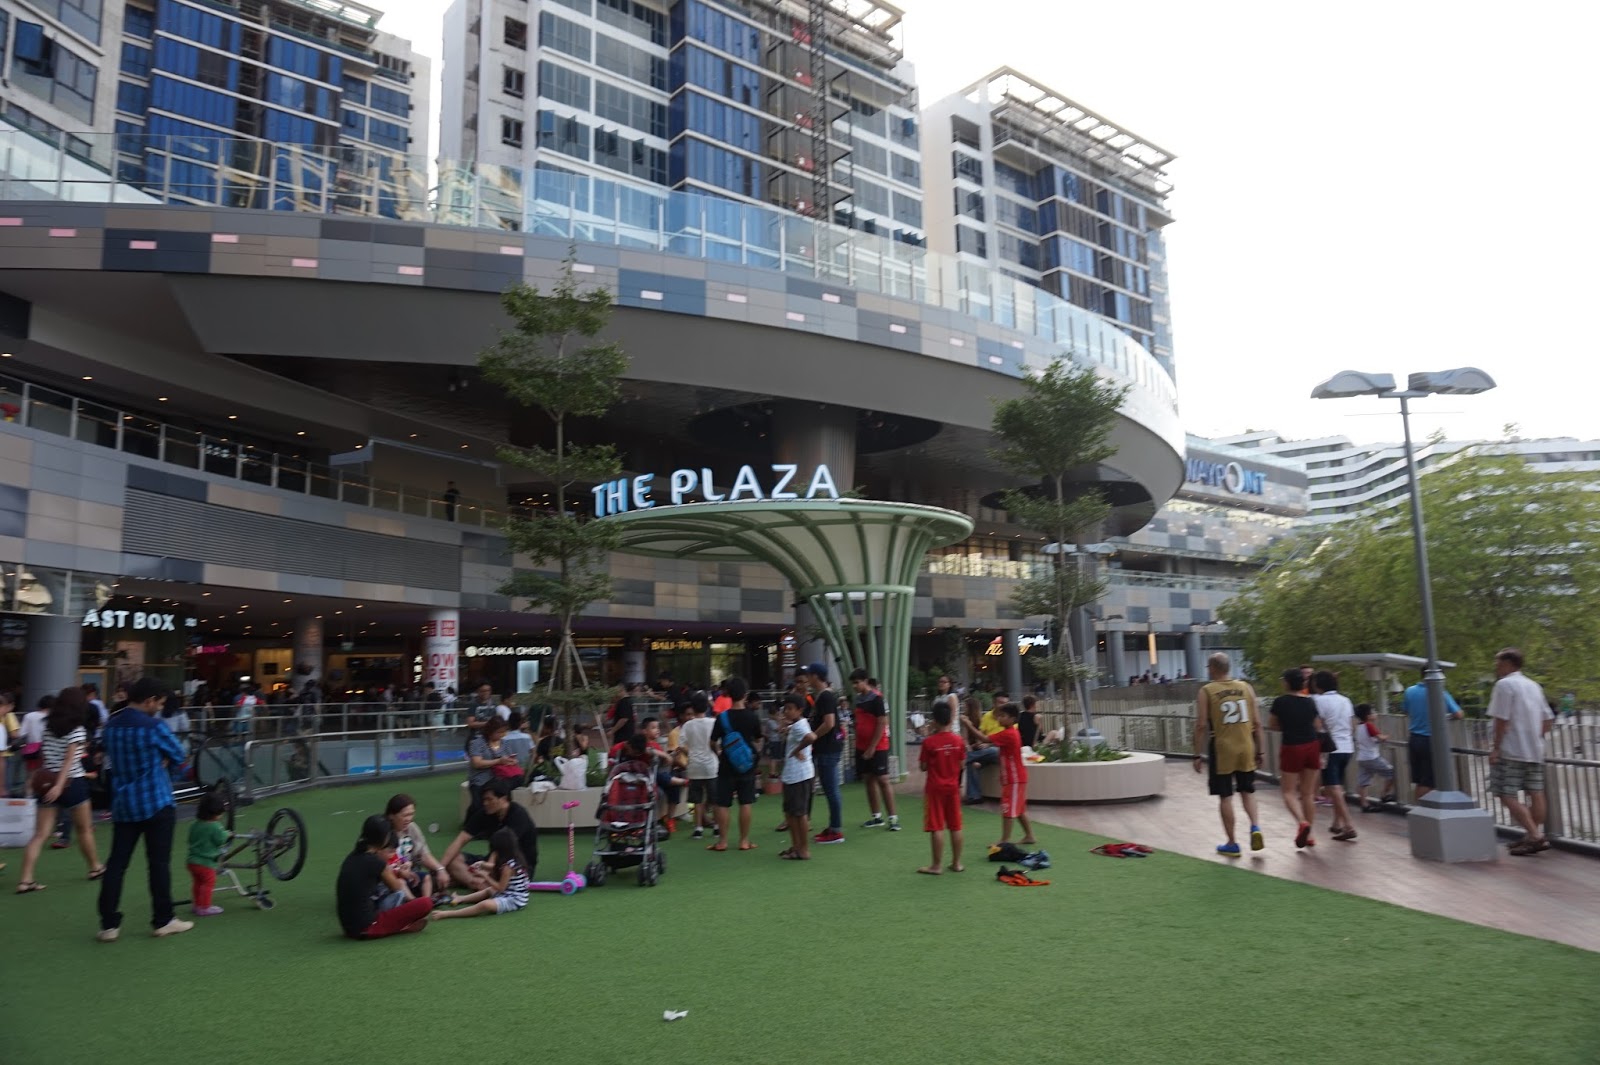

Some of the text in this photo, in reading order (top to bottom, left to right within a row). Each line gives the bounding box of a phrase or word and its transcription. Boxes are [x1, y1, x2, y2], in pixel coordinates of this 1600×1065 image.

[591, 464, 839, 517] THE PLAZA
[133, 611, 175, 631] BOX
[477, 646, 515, 656] OSAKA
[425, 668, 456, 680] PEN
[1220, 699, 1249, 724] 21
